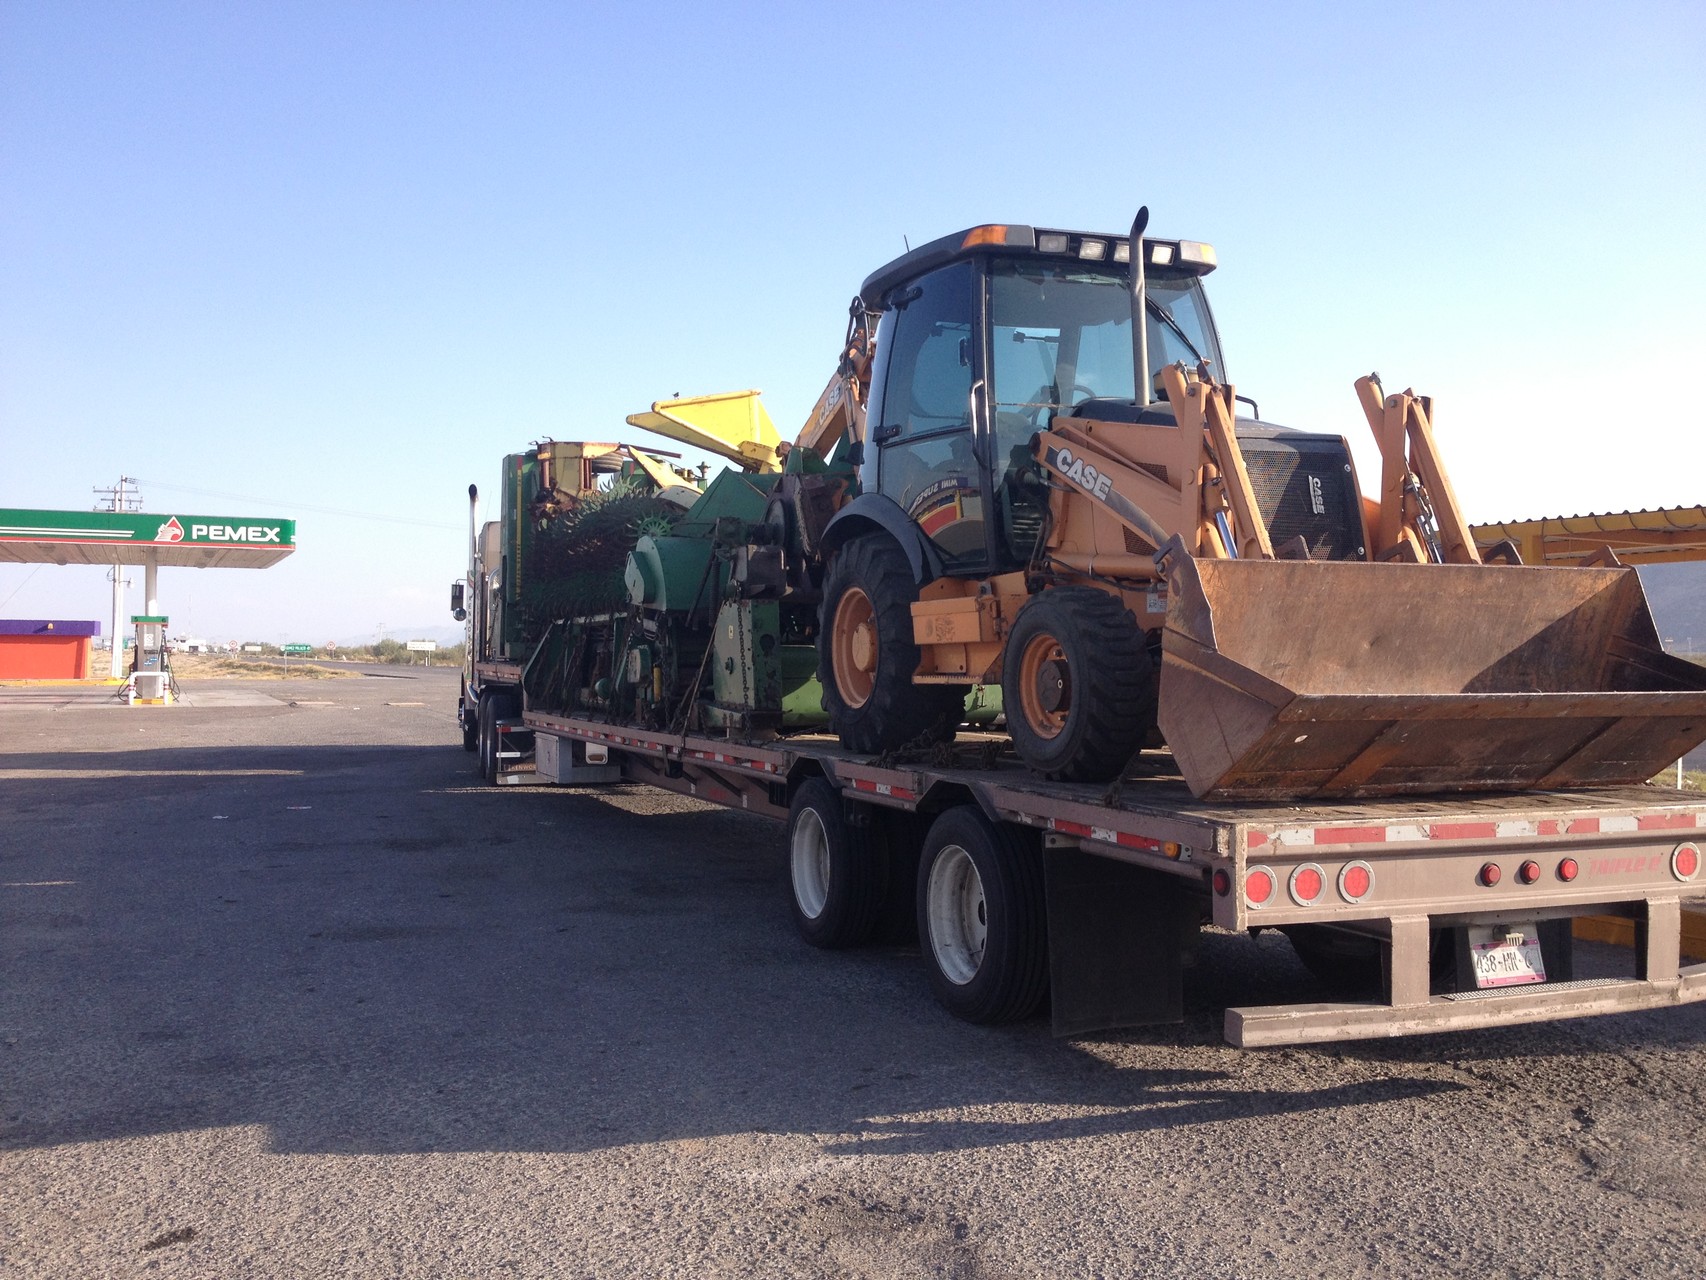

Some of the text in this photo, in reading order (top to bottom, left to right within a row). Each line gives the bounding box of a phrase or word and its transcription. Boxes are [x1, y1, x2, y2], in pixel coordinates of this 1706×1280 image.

[819, 382, 842, 426] CASE
[1056, 448, 1112, 500] CASE
[1313, 478, 1325, 514] CASE
[191, 524, 281, 543] PEMEX
